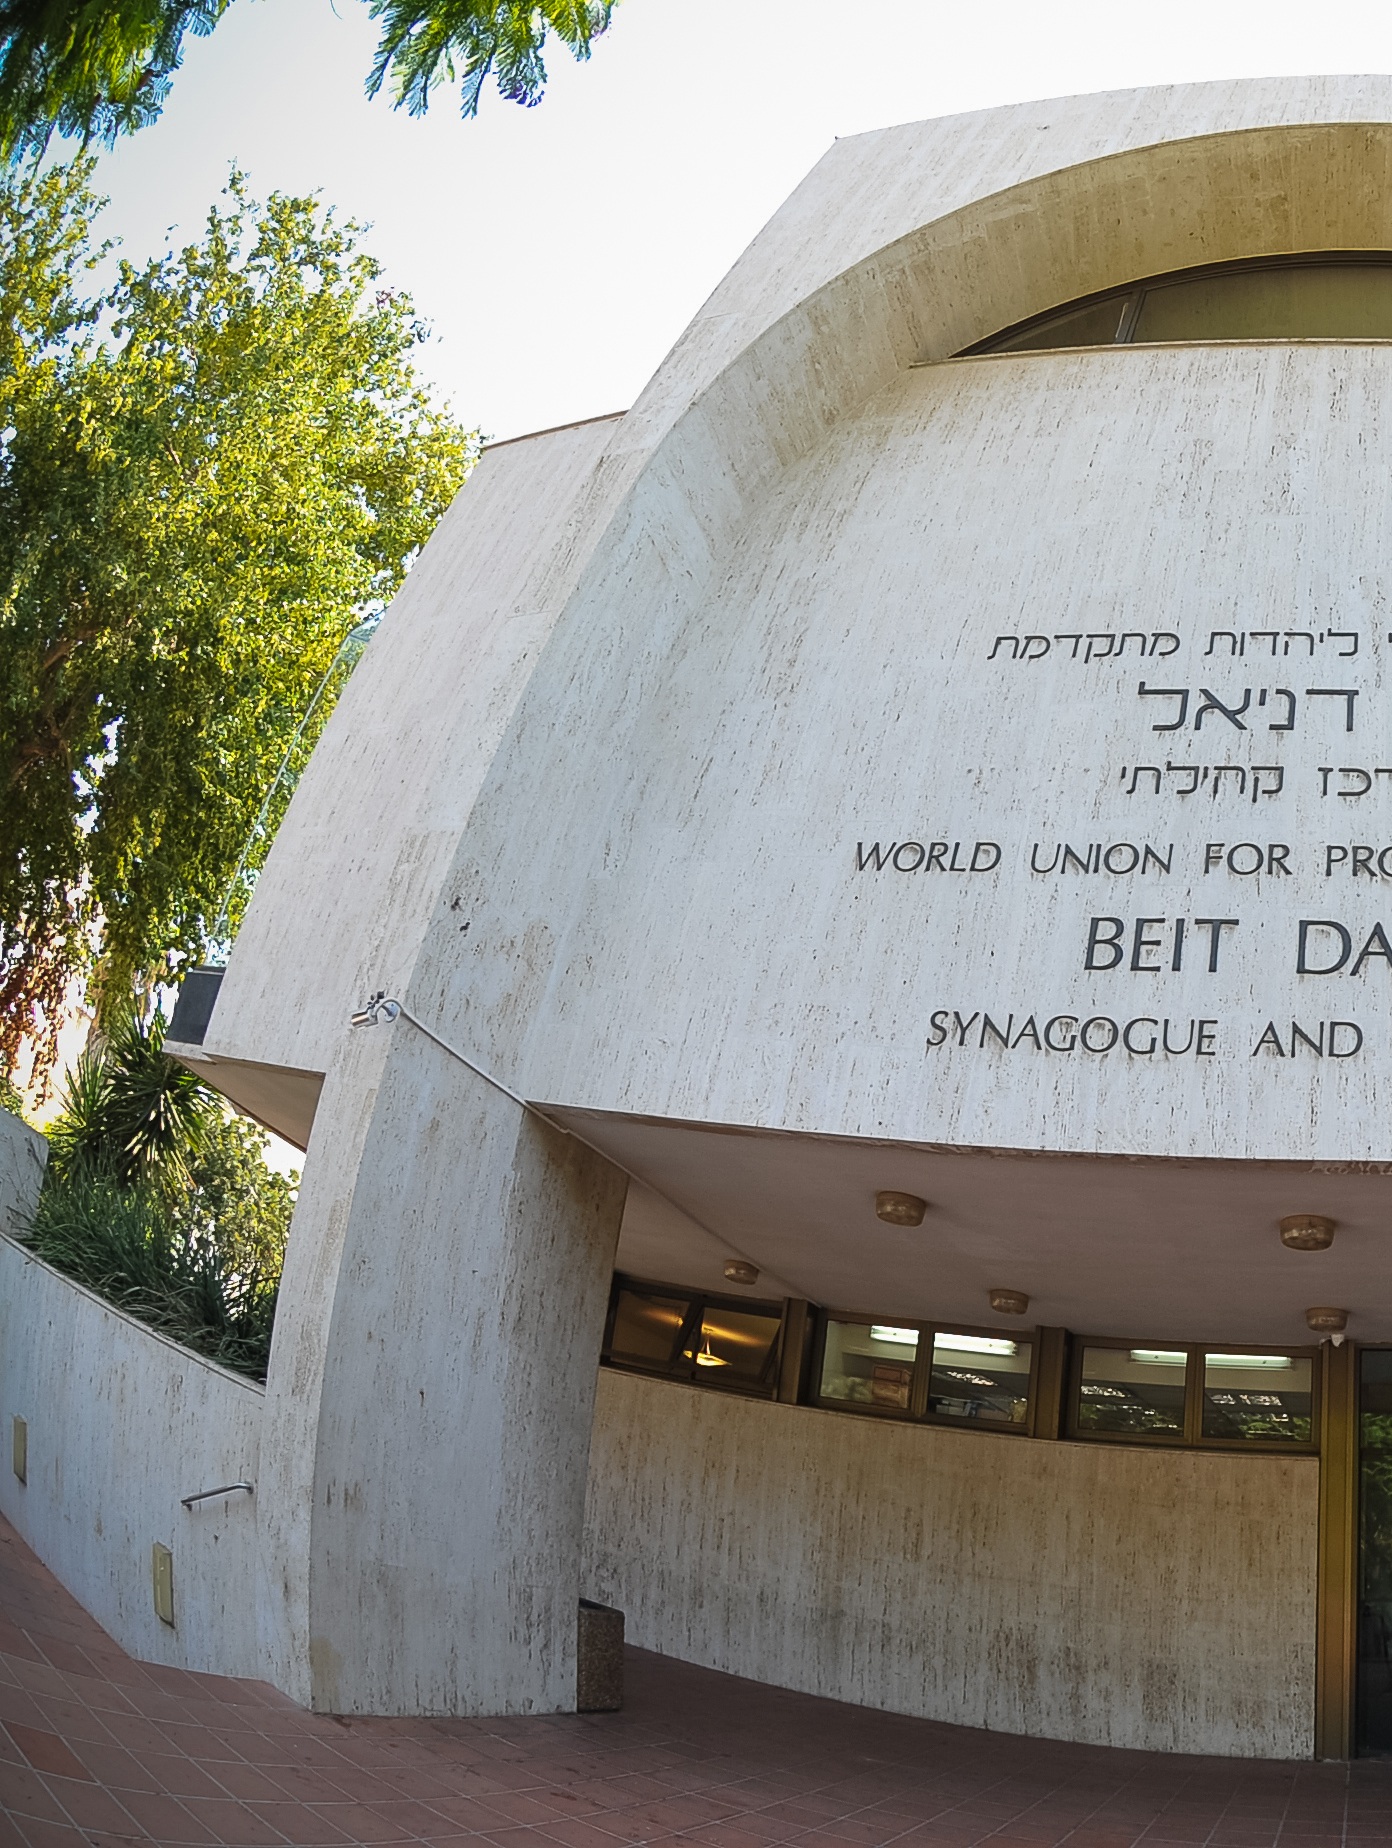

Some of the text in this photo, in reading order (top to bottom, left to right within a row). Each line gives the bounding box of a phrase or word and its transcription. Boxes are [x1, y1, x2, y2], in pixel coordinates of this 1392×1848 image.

[987, 632, 1180, 664] מתקדמת
[1204, 628, 1359, 657] ליהדות
[1138, 681, 1359, 731] דניאל
[1120, 761, 1284, 803] קהילתי
[855, 841, 1002, 873] WORLD
[1030, 843, 1175, 875] UNION
[1203, 843, 1294, 876] FOR
[1083, 916, 1240, 973] BEIT
[926, 1010, 1218, 1057] SYNAGOGUE
[1252, 1021, 1364, 1058] AND
